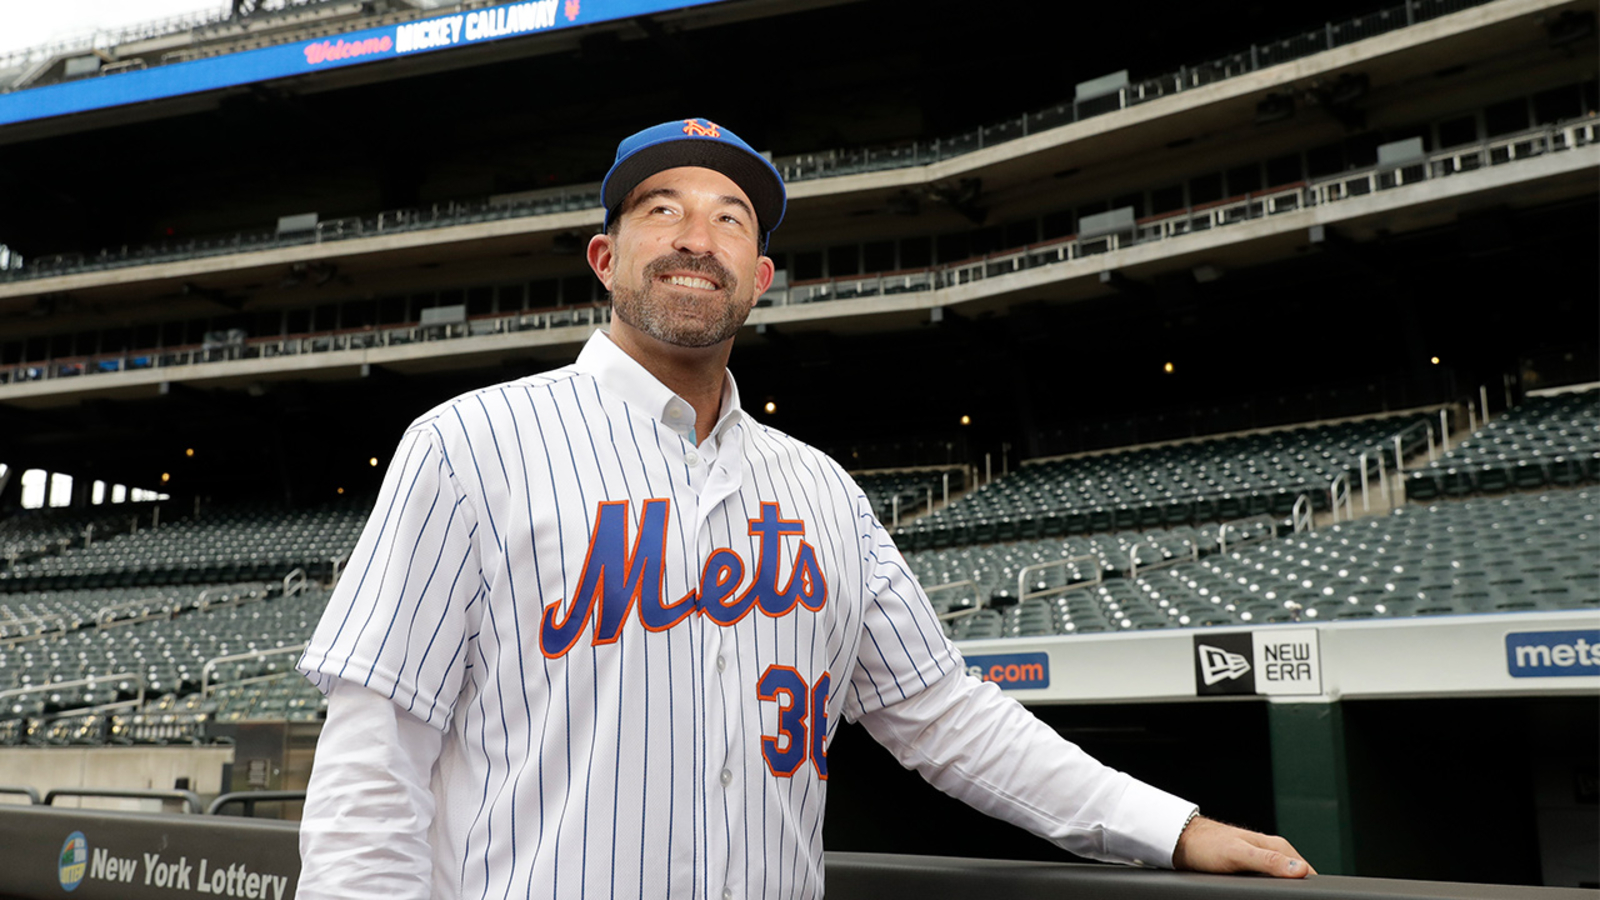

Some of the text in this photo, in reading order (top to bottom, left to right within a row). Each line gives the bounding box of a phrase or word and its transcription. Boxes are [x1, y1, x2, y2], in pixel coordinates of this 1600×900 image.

[304, 35, 393, 64] Welcome
[396, 15, 464, 53] MICKEY
[465, 0, 559, 41] CALLAWAY
[539, 498, 828, 659] Mets
[1264, 643, 1310, 661] NEW
[1265, 663, 1311, 681] ERA
[90, 848, 137, 883] New
[143, 853, 192, 890] York
[197, 859, 288, 900] Lottery
